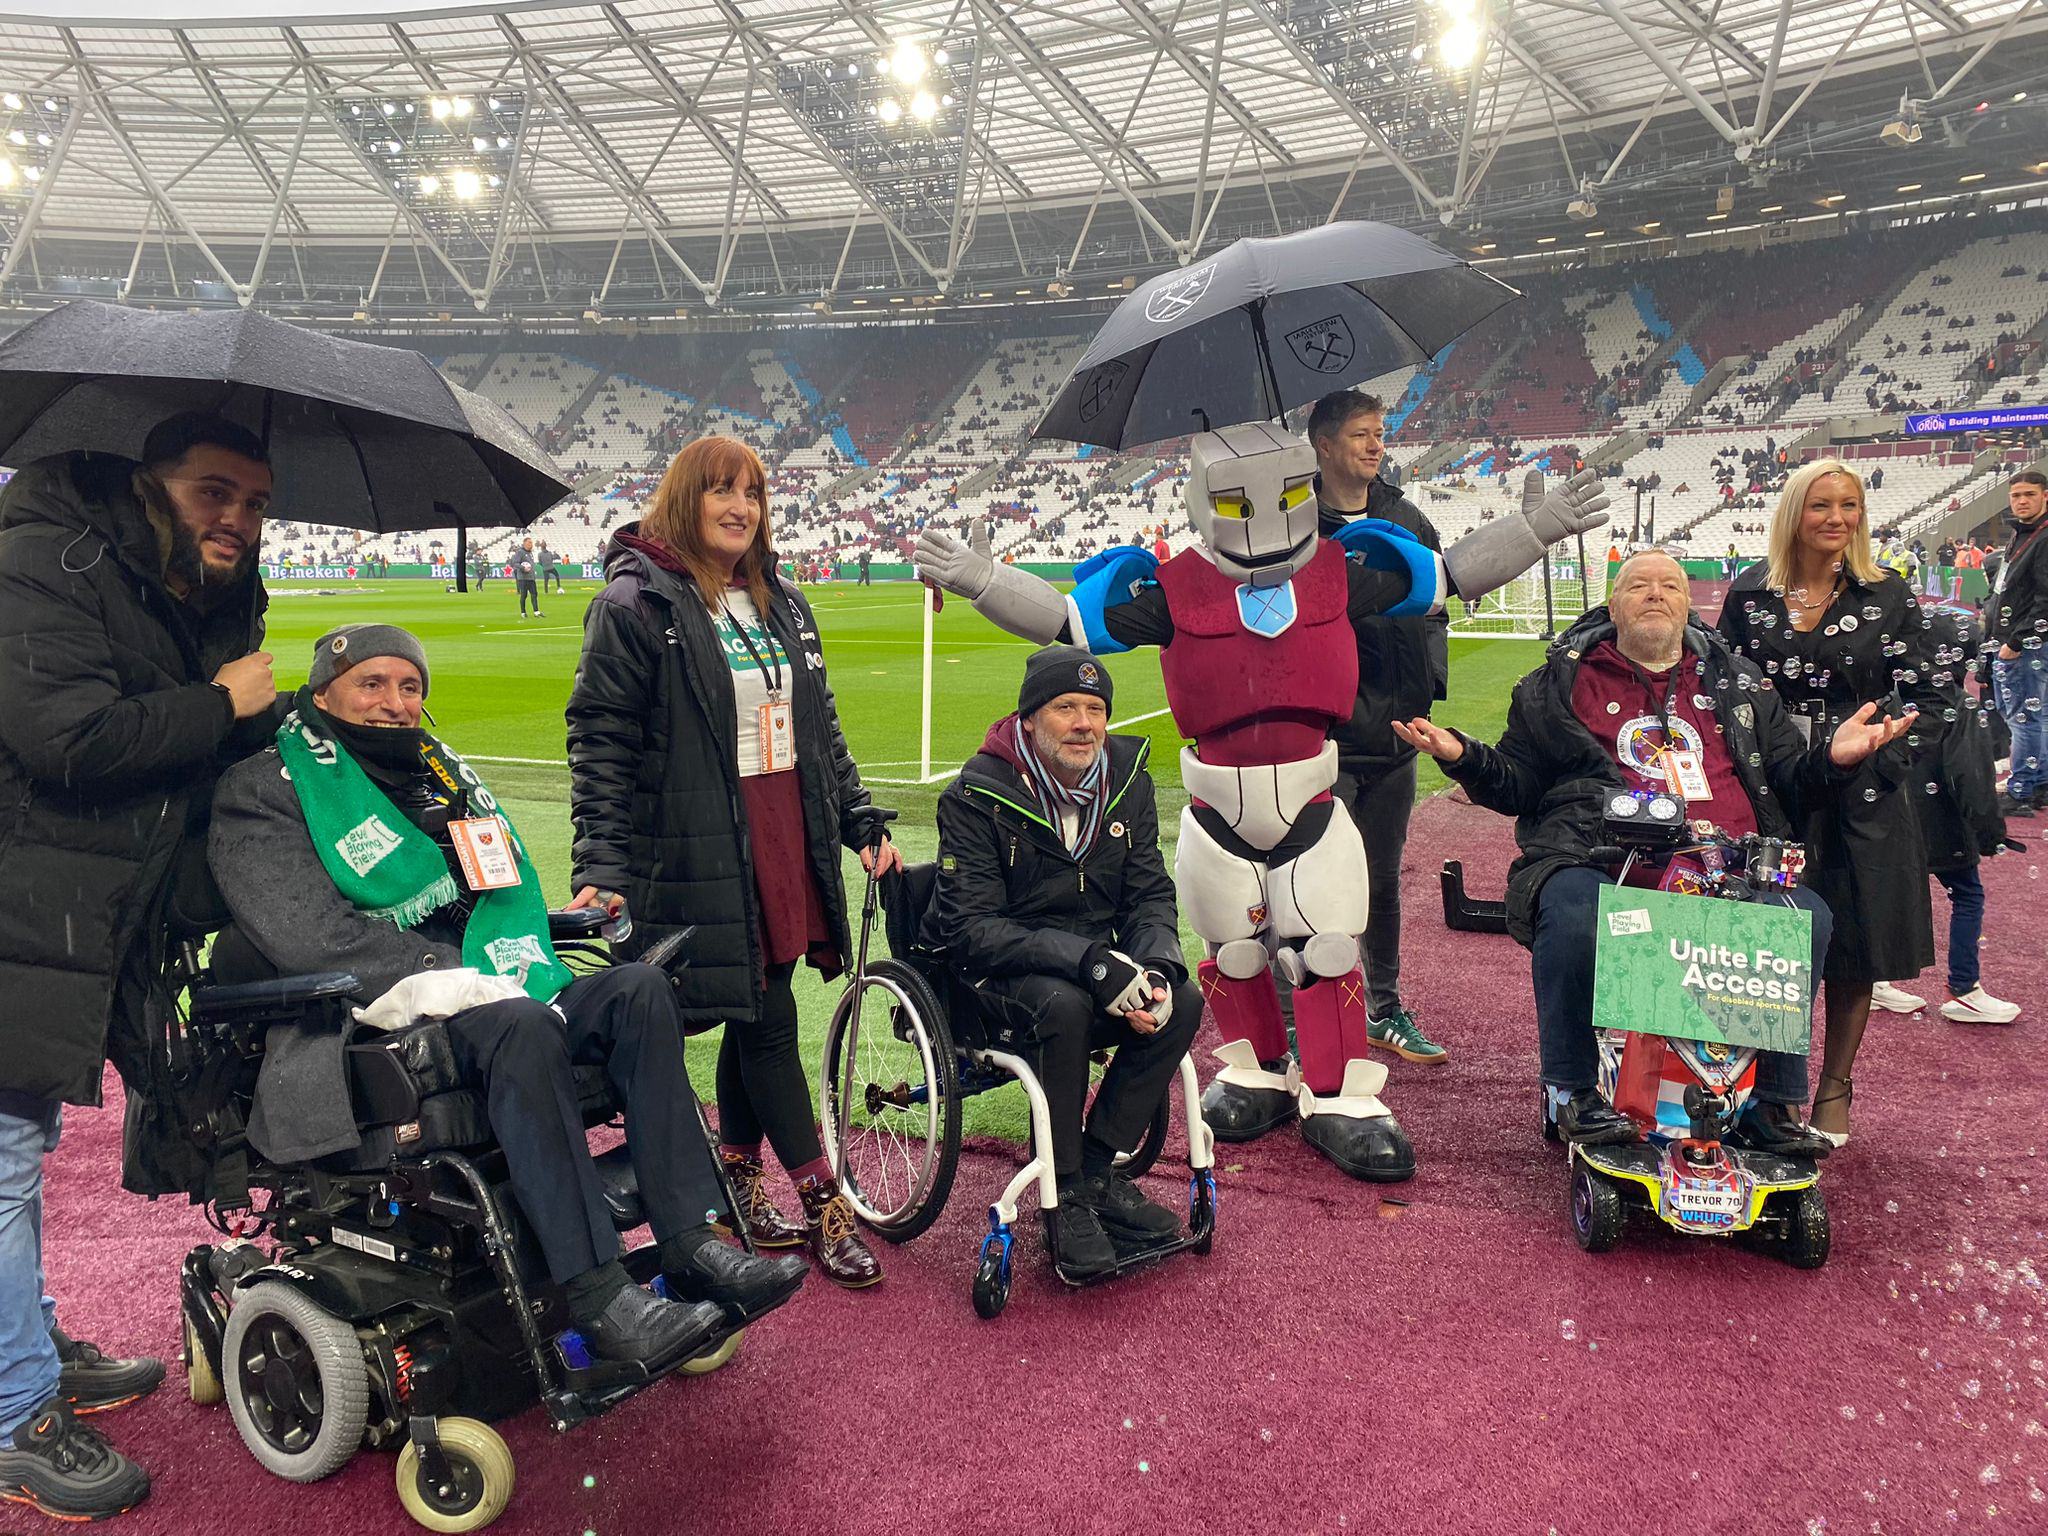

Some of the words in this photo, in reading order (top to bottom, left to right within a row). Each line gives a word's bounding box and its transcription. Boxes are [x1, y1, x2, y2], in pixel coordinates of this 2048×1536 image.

[2014, 343, 2030, 352] 230
[1948, 416, 1990, 427] Building
[460, 845, 481, 888] MATCHDAY
[1612, 912, 1632, 920] Level
[1612, 919, 1641, 930] Playing
[1612, 925, 1630, 933] Field
[1670, 938, 1748, 969] Unite
[1755, 949, 1801, 976] For
[1681, 963, 1801, 1002] Access
[1707, 993, 1721, 1001] For
[1721, 995, 1754, 1006] disabled
[1756, 999, 1781, 1009] sports
[1782, 1003, 1801, 1013] fans
[1681, 1194, 1722, 1206] TREVOR
[1727, 1197, 1740, 1206] 70
[1680, 1211, 1732, 1225] WHUFC
